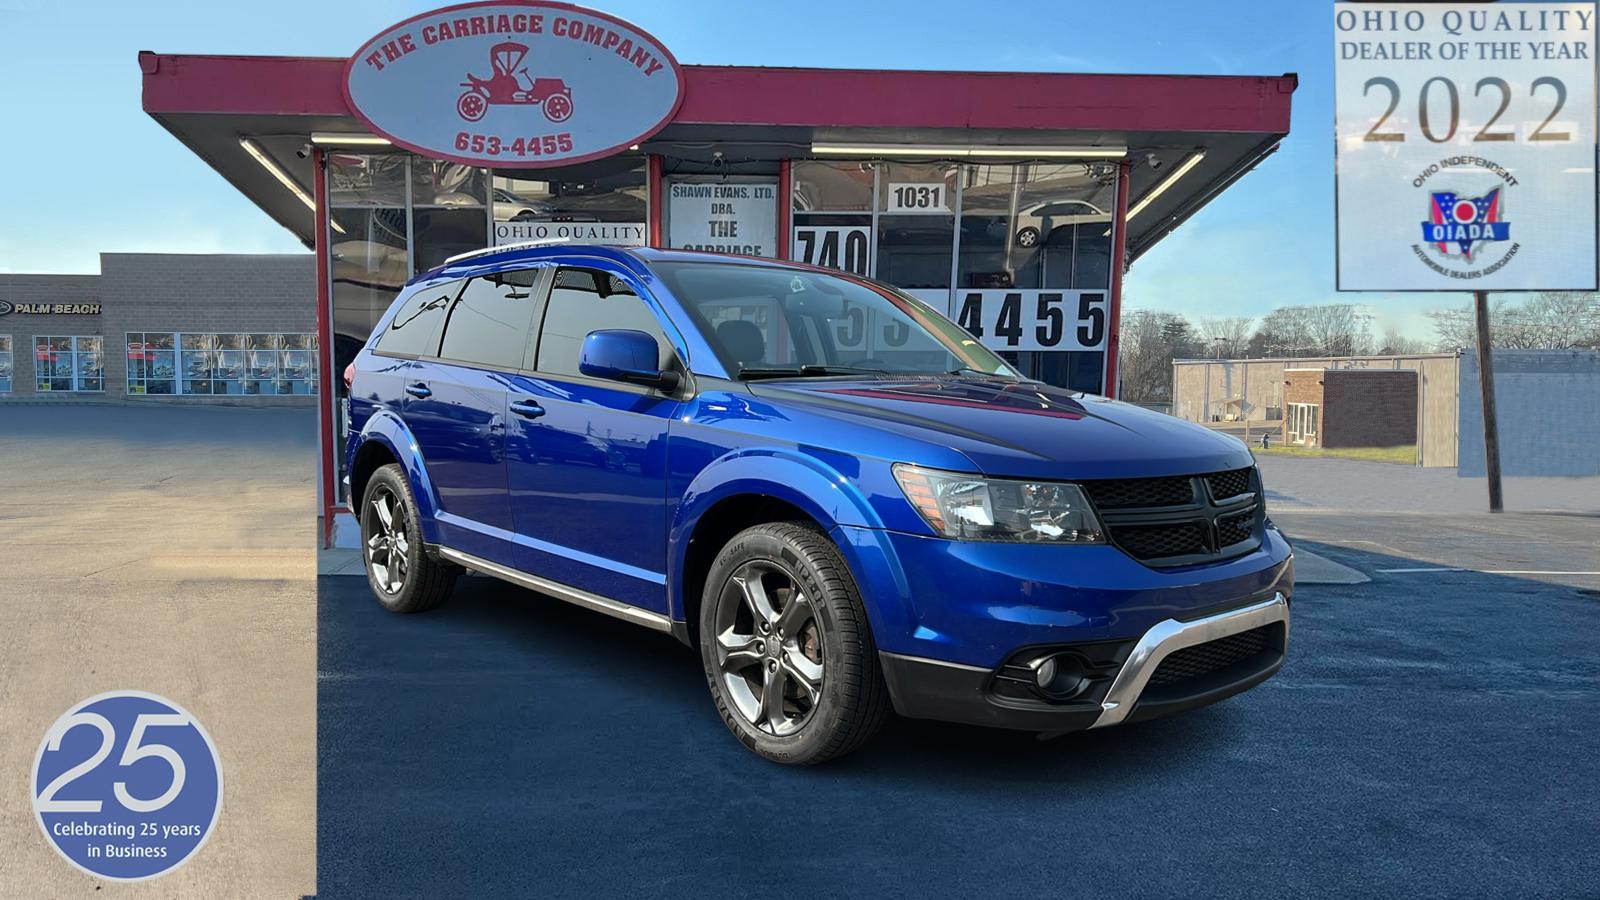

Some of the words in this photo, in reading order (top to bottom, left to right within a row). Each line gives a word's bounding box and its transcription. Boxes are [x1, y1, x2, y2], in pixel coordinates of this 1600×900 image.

[1336, 10, 1425, 31] OHIO
[1442, 10, 1593, 35] QUALITY
[366, 33, 416, 72] THE
[422, 14, 543, 45] CARRIAGE
[552, 17, 664, 77] COMPANY
[1340, 42, 1432, 60] DEALER
[1439, 42, 1469, 60] OF
[1475, 42, 1521, 60] THE
[1528, 42, 1589, 60] YEAR
[1363, 76, 1571, 143] 2022
[455, 131, 573, 156] 653-4455
[1412, 164, 1440, 188] OHIO
[1440, 155, 1519, 187] INDEPENDENT
[672, 185, 712, 199] SHAWN
[754, 187, 775, 200] LTD.
[894, 187, 941, 209] 1031
[711, 203, 736, 216] DBA.
[497, 226, 548, 239] OHIO
[557, 226, 644, 239] QUALITY
[708, 221, 738, 238] THE
[1432, 224, 1495, 241] OIADA
[797, 230, 867, 277] 740
[14, 304, 51, 314] PALM
[54, 304, 100, 314] BEACH
[957, 293, 1105, 347] 4455
